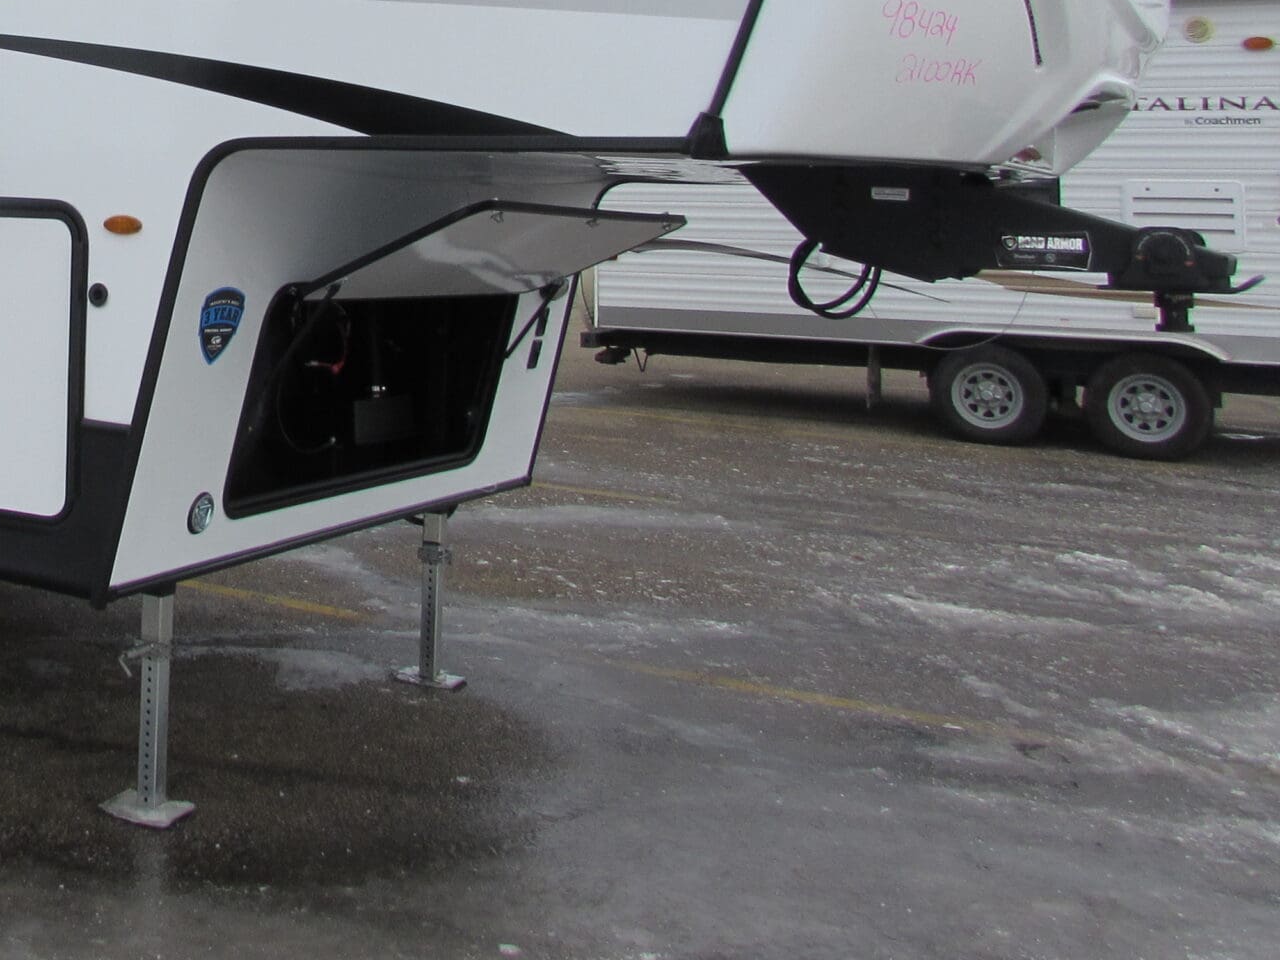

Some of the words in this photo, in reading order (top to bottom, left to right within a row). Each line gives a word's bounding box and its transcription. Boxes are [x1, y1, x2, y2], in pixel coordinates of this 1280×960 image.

[1195, 116, 1262, 125] Coachmen
[1018, 236, 1045, 249] ROAD
[1047, 237, 1083, 250] ARMOR
